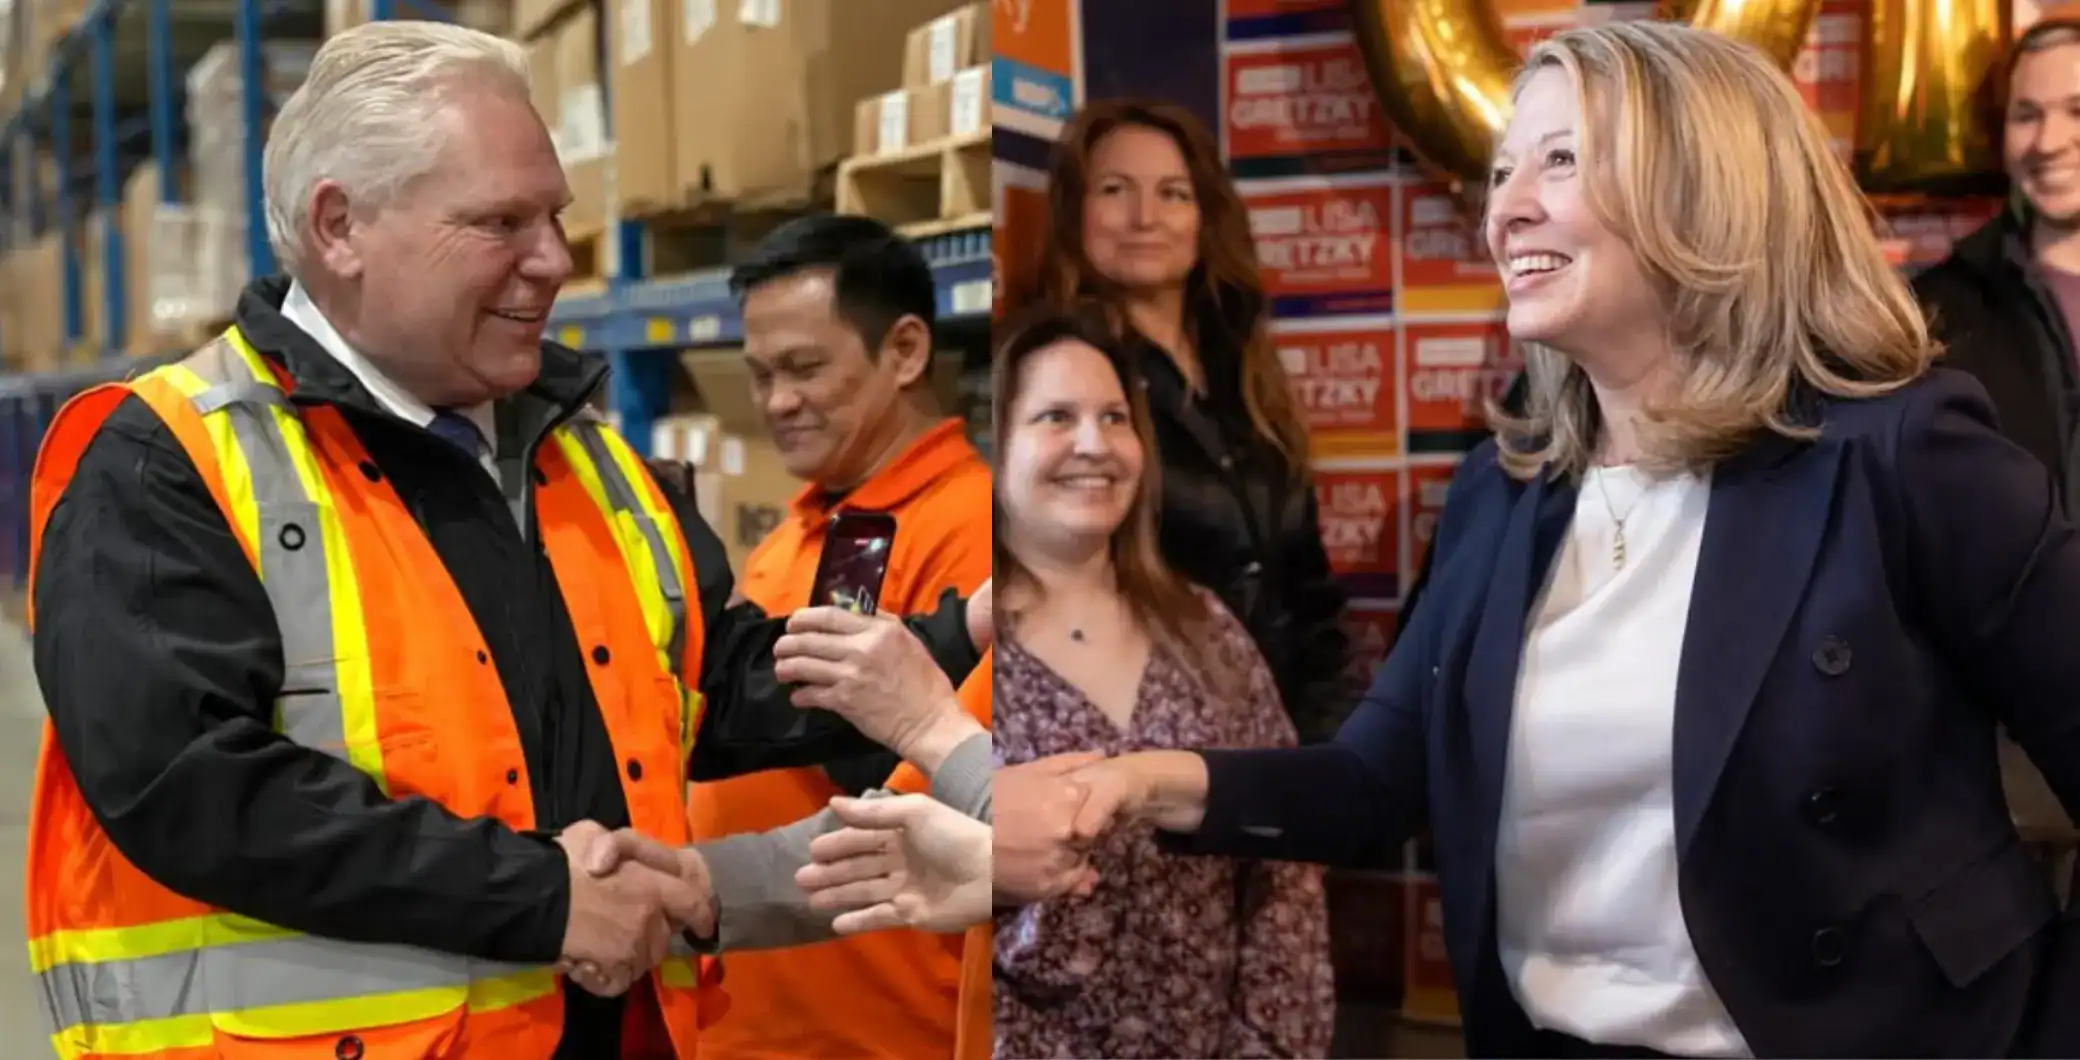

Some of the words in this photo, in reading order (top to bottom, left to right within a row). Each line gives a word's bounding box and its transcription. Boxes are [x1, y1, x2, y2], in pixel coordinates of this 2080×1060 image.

[1232, 94, 1373, 129] GRETZKY
[1303, 199, 1380, 233] LISA
[1256, 234, 1376, 268] RETZKY
[1306, 341, 1383, 377] LISA
[1298, 377, 1380, 409] TZKY
